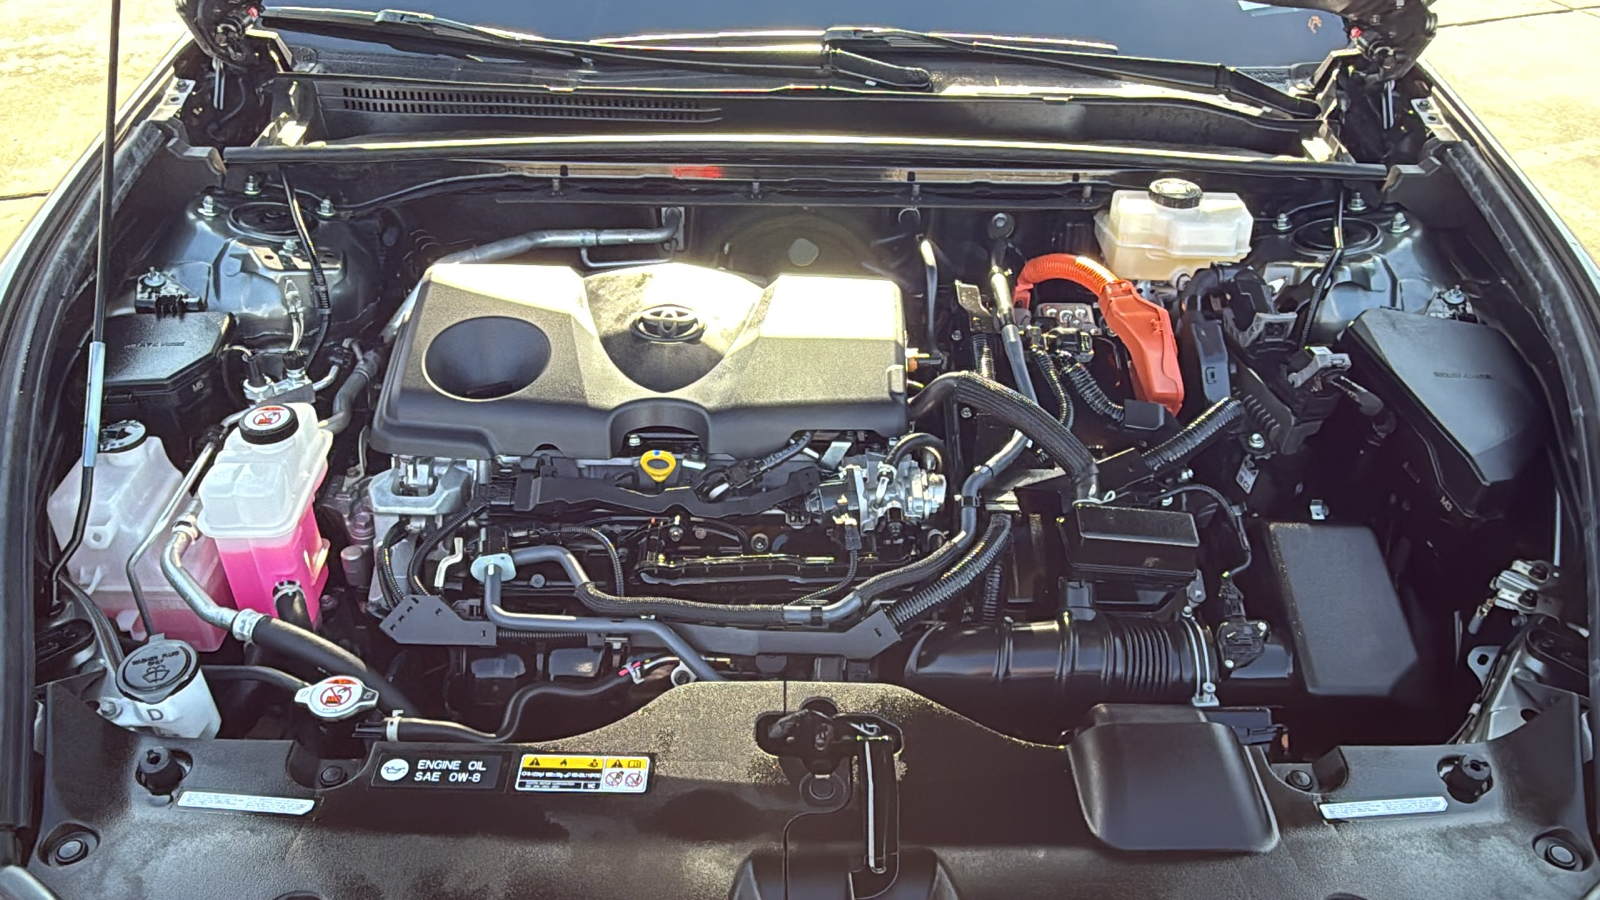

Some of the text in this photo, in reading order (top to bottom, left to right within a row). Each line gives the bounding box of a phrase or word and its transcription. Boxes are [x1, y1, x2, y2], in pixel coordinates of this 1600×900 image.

[417, 759, 487, 771] ENGINE OIL
[414, 771, 441, 782] SAE
